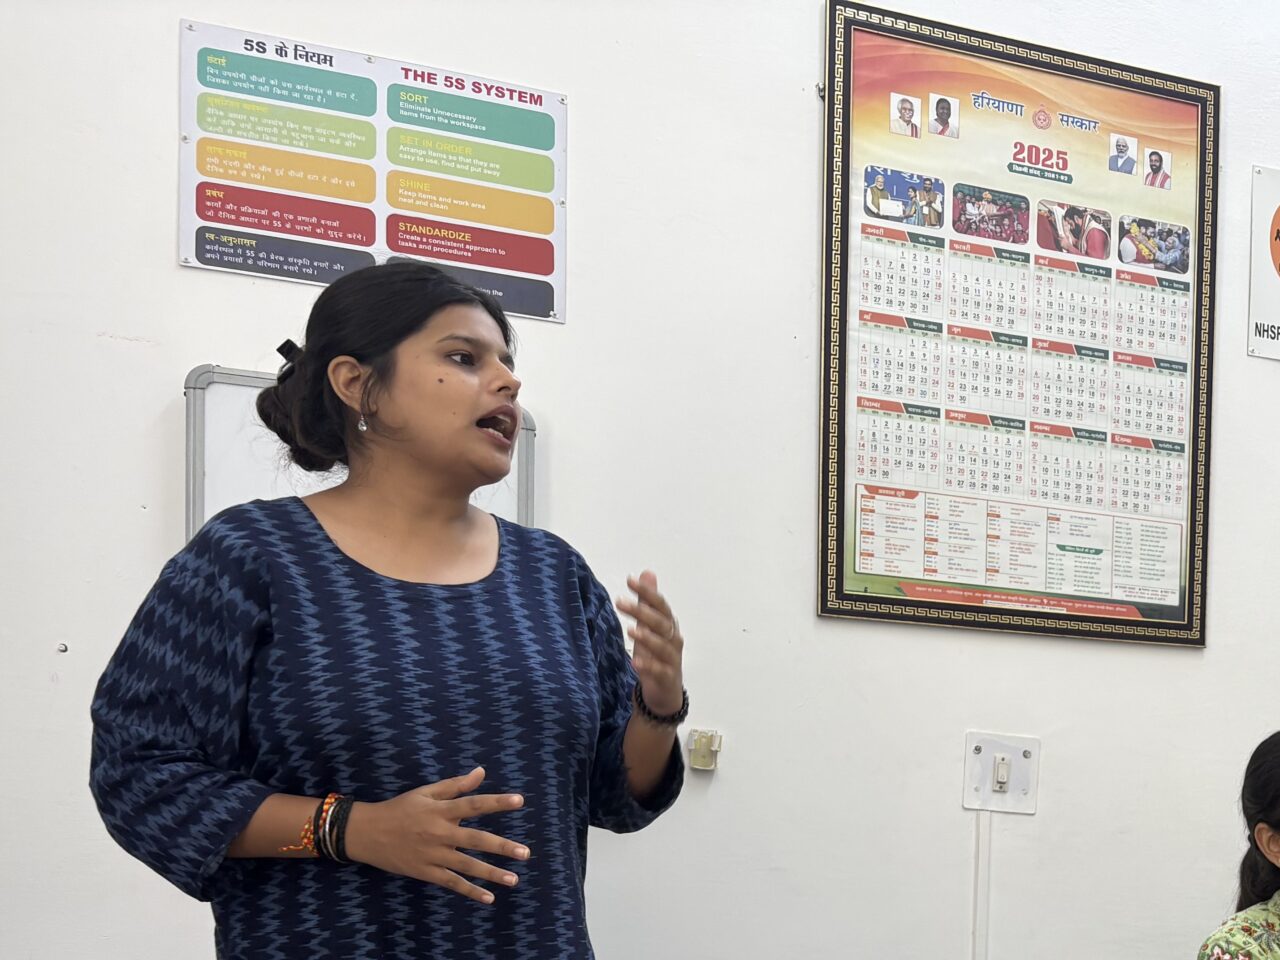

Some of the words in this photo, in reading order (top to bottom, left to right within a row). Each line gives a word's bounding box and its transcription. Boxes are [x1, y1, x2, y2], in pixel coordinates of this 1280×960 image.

[244, 39, 267, 54] 5S
[275, 42, 288, 57] के
[294, 44, 333, 67] नियम
[401, 67, 437, 85] THE
[444, 76, 465, 90] 5S
[472, 81, 543, 106] SYSTEM
[400, 92, 428, 104] SORT
[400, 102, 431, 113] Eliminate
[433, 108, 476, 122] Unnecessary
[972, 91, 1024, 117] हरियाणा
[1058, 112, 1099, 132] सरकार
[420, 113, 436, 122] from
[450, 119, 486, 131] workspace
[400, 135, 418, 145] SET
[423, 139, 433, 148] IN
[436, 142, 472, 155] ORDER
[399, 145, 427, 156] Arrange
[458, 155, 472, 164] that
[473, 158, 488, 168] they
[399, 153, 415, 162] easy
[417, 155, 424, 163] to
[441, 160, 454, 168] find
[456, 162, 469, 171] and
[471, 164, 482, 174] put
[483, 167, 500, 177] away
[1012, 141, 1068, 171] 2025
[400, 179, 430, 192] SHINE
[399, 189, 417, 198] Keep
[439, 194, 451, 203] and
[453, 197, 469, 206] work
[471, 201, 486, 210] area
[399, 197, 414, 205] neat
[416, 199, 428, 207] and
[430, 201, 448, 211] clean
[398, 222, 472, 242] STANDARDIZE
[398, 233, 421, 242] Create
[429, 238, 464, 250] consistent
[466, 244, 497, 255] approach
[398, 240, 417, 249] tasks
[419, 242, 432, 251] and
[434, 245, 472, 258] procedures
